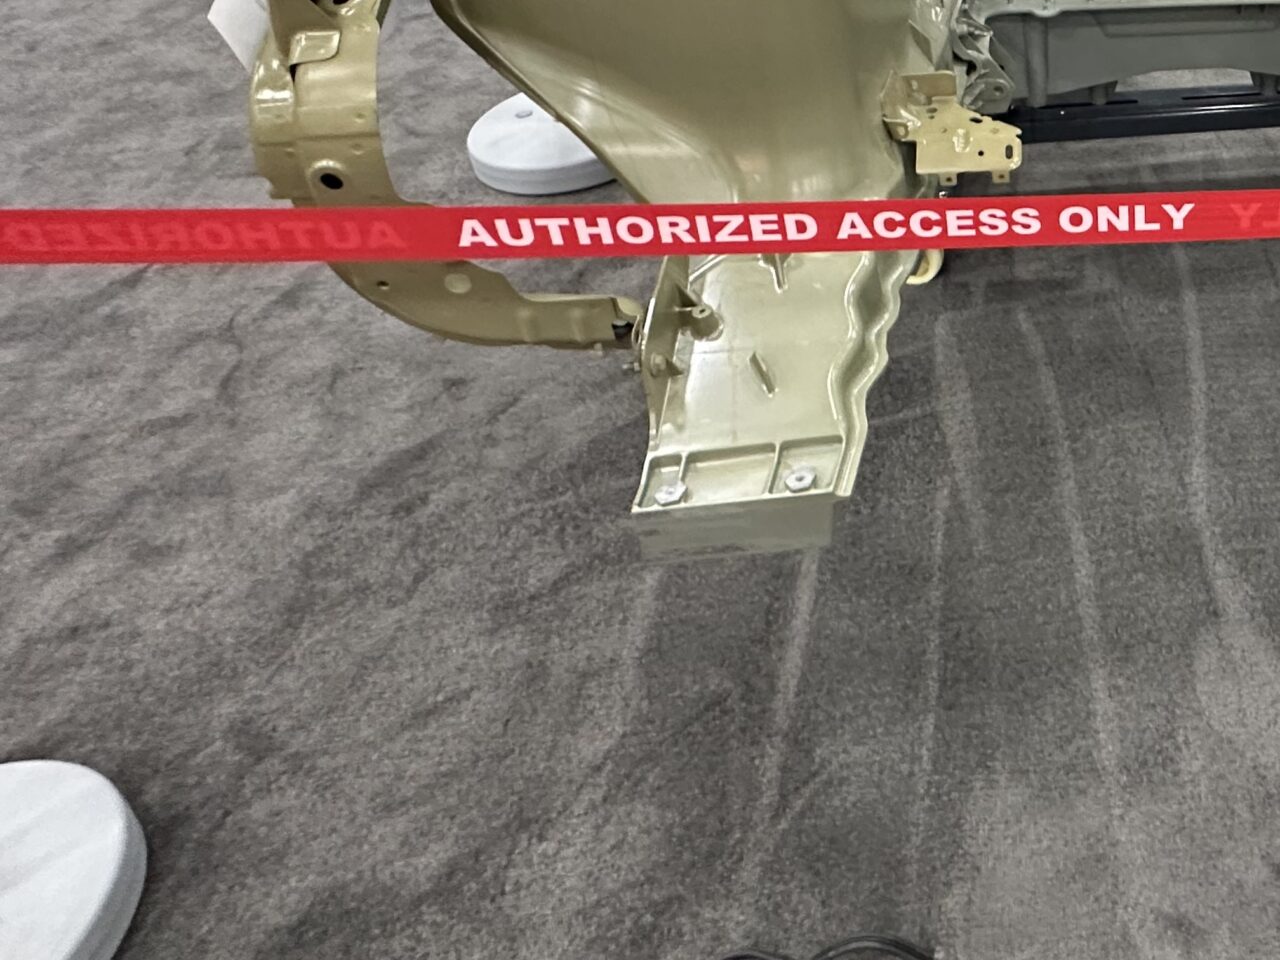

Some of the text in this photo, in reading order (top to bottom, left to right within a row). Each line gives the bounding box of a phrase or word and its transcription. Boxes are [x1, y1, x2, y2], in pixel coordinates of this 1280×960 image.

[458, 203, 1196, 248] AUTHORIZED ACCESS ONLY
